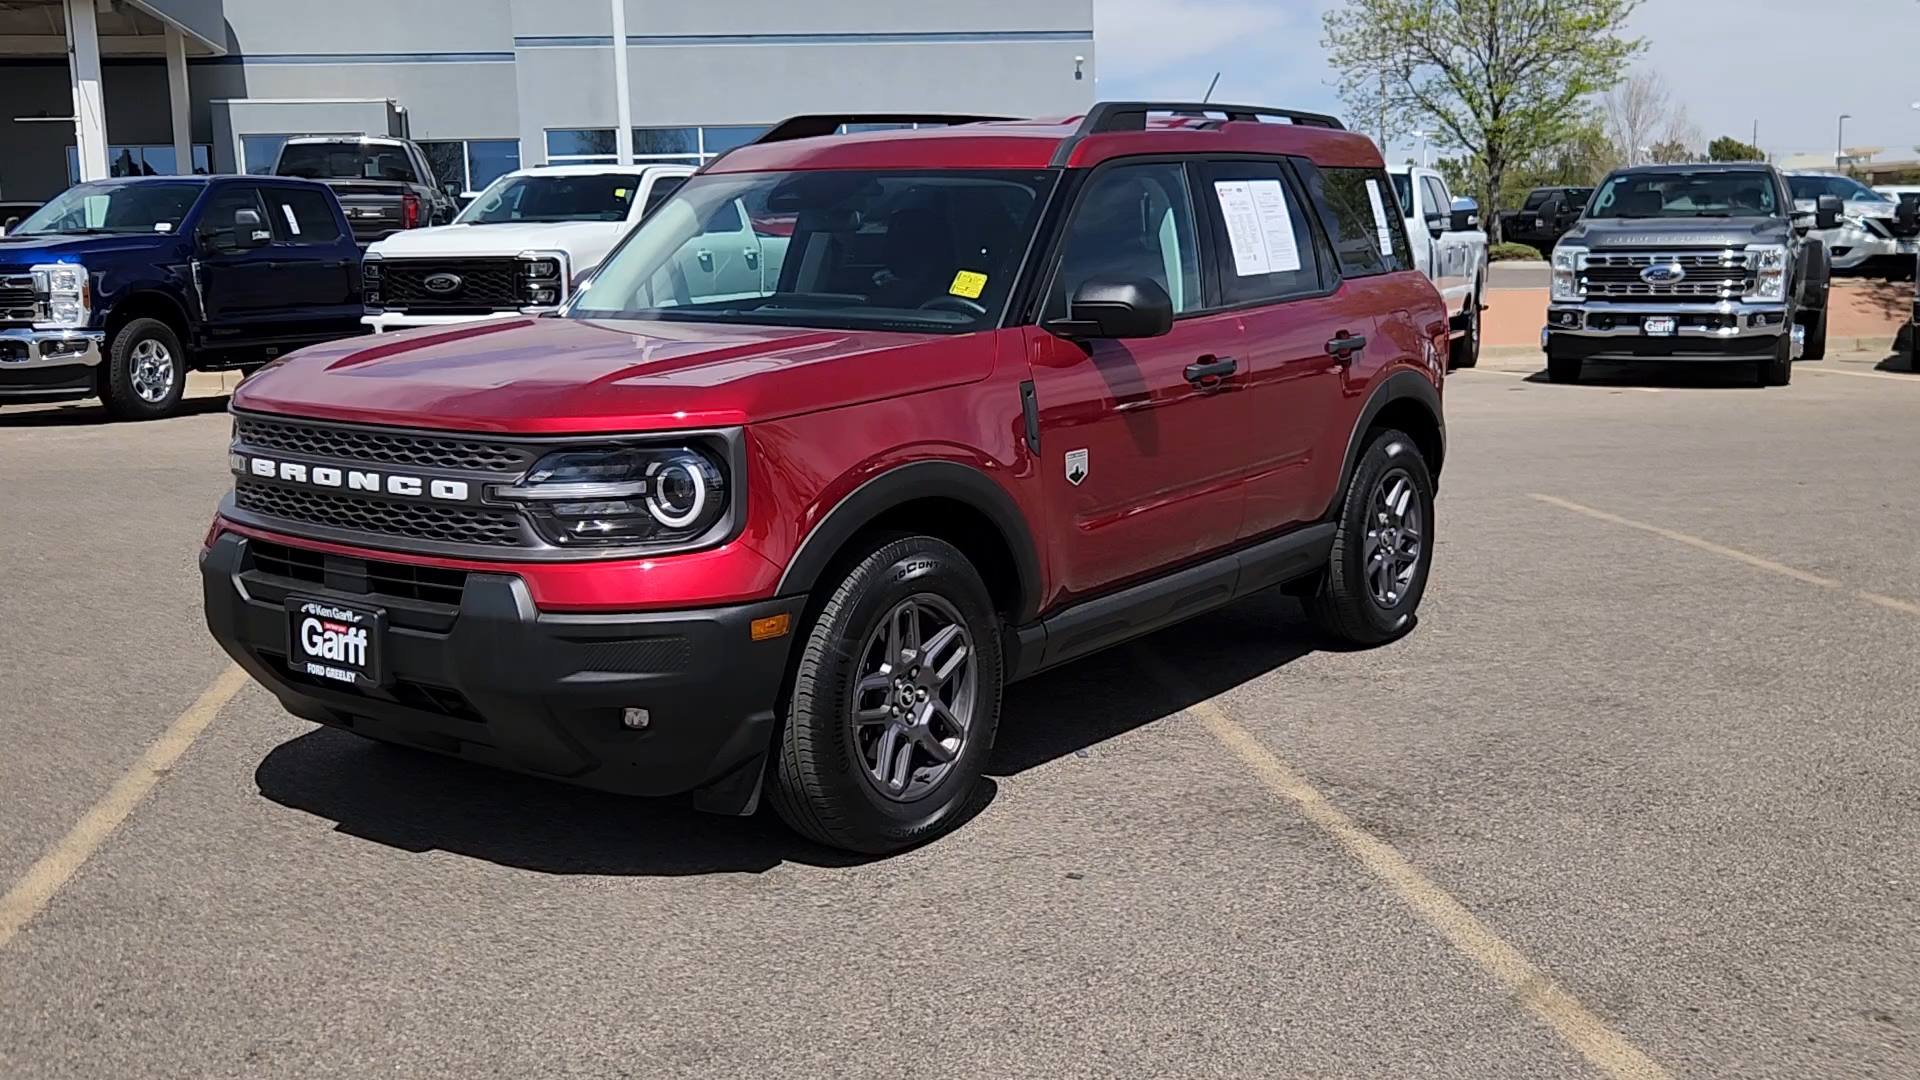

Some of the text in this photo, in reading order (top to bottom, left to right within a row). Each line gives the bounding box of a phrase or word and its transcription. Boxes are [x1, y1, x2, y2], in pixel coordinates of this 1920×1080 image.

[251, 458, 468, 500] BRONCO
[315, 604, 332, 618] Ken
[301, 617, 368, 666] Garff
[306, 662, 356, 683] FORD GREELEY
